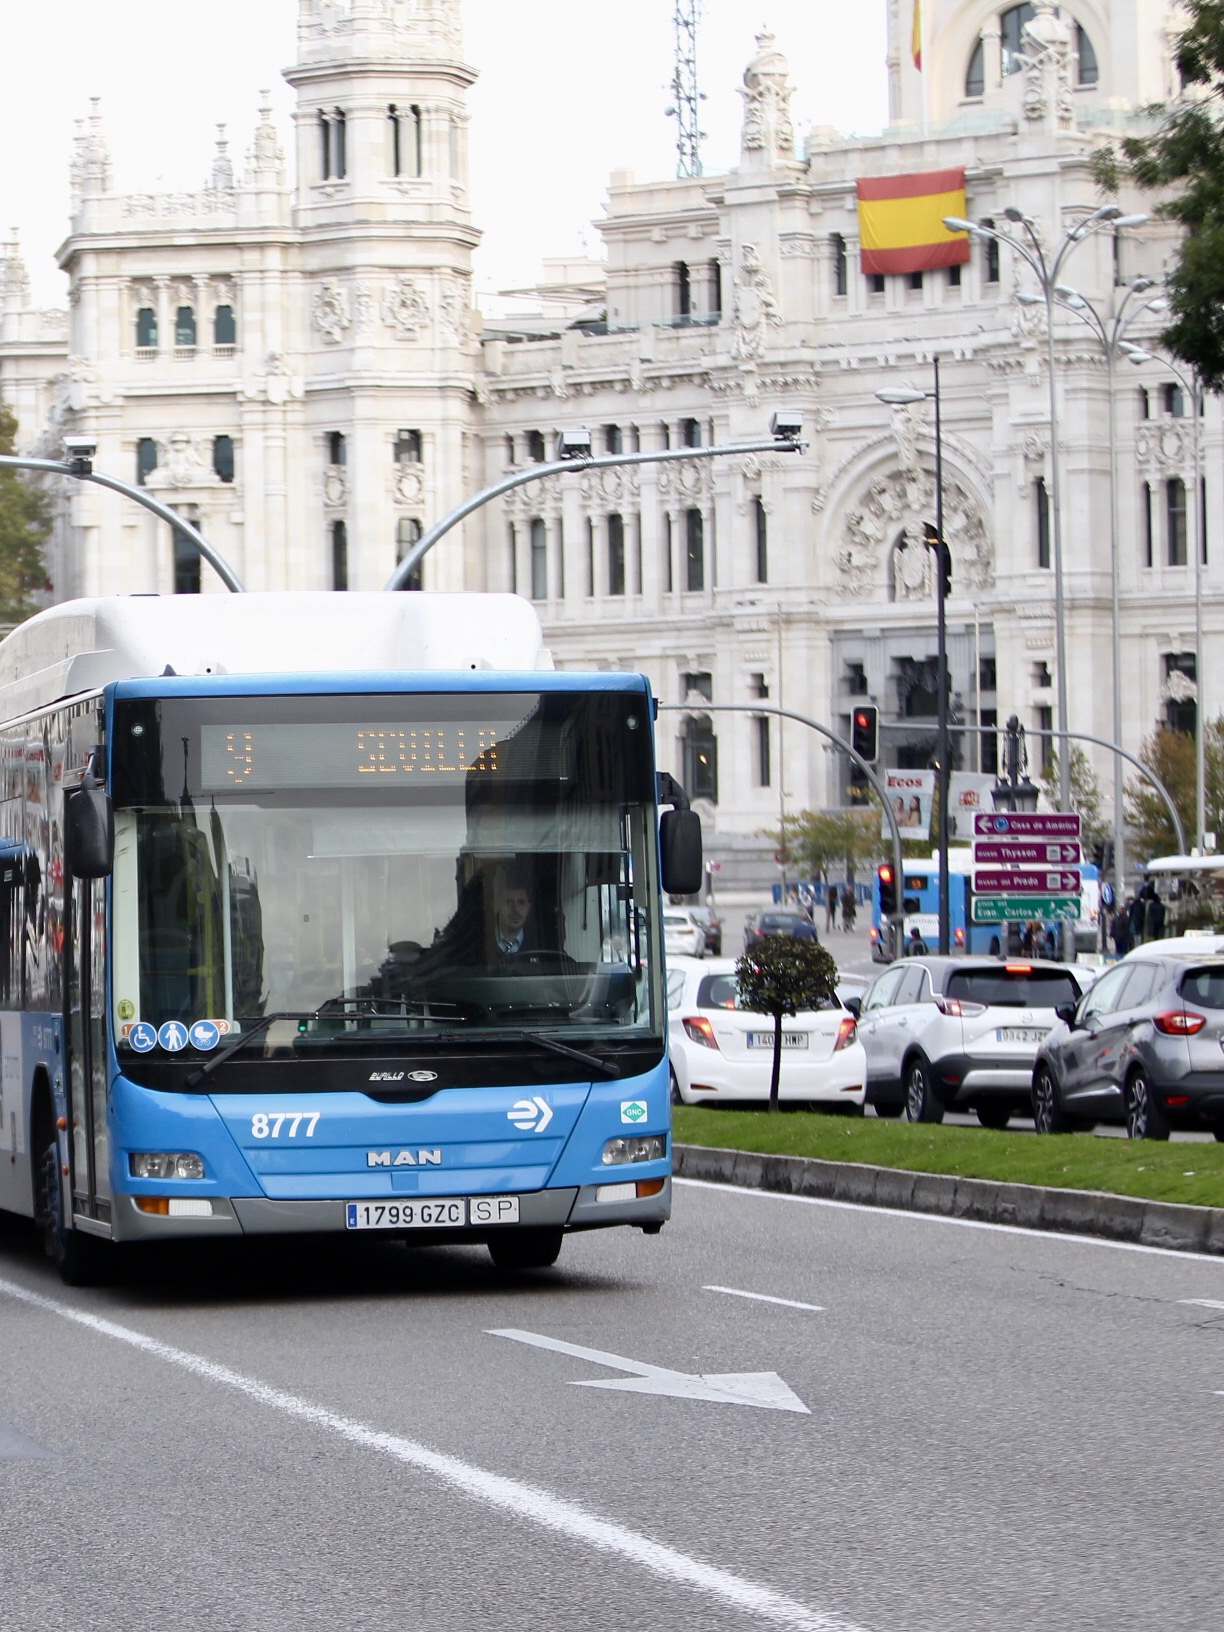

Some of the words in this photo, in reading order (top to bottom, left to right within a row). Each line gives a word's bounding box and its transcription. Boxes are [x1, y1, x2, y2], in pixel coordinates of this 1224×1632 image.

[887, 776, 923, 787] Ecos
[1010, 821, 1030, 831] Casa
[1001, 848, 1037, 860] Thyssen
[1013, 876, 1039, 886] Prado
[123, 1025, 129, 1034] 1
[219, 1022, 226, 1032] 2
[626, 1108, 642, 1116] GNC
[251, 1112, 321, 1139] 8777
[367, 1150, 442, 1167] MAN
[363, 1205, 414, 1226] 1799
[420, 1203, 460, 1223] GZC
